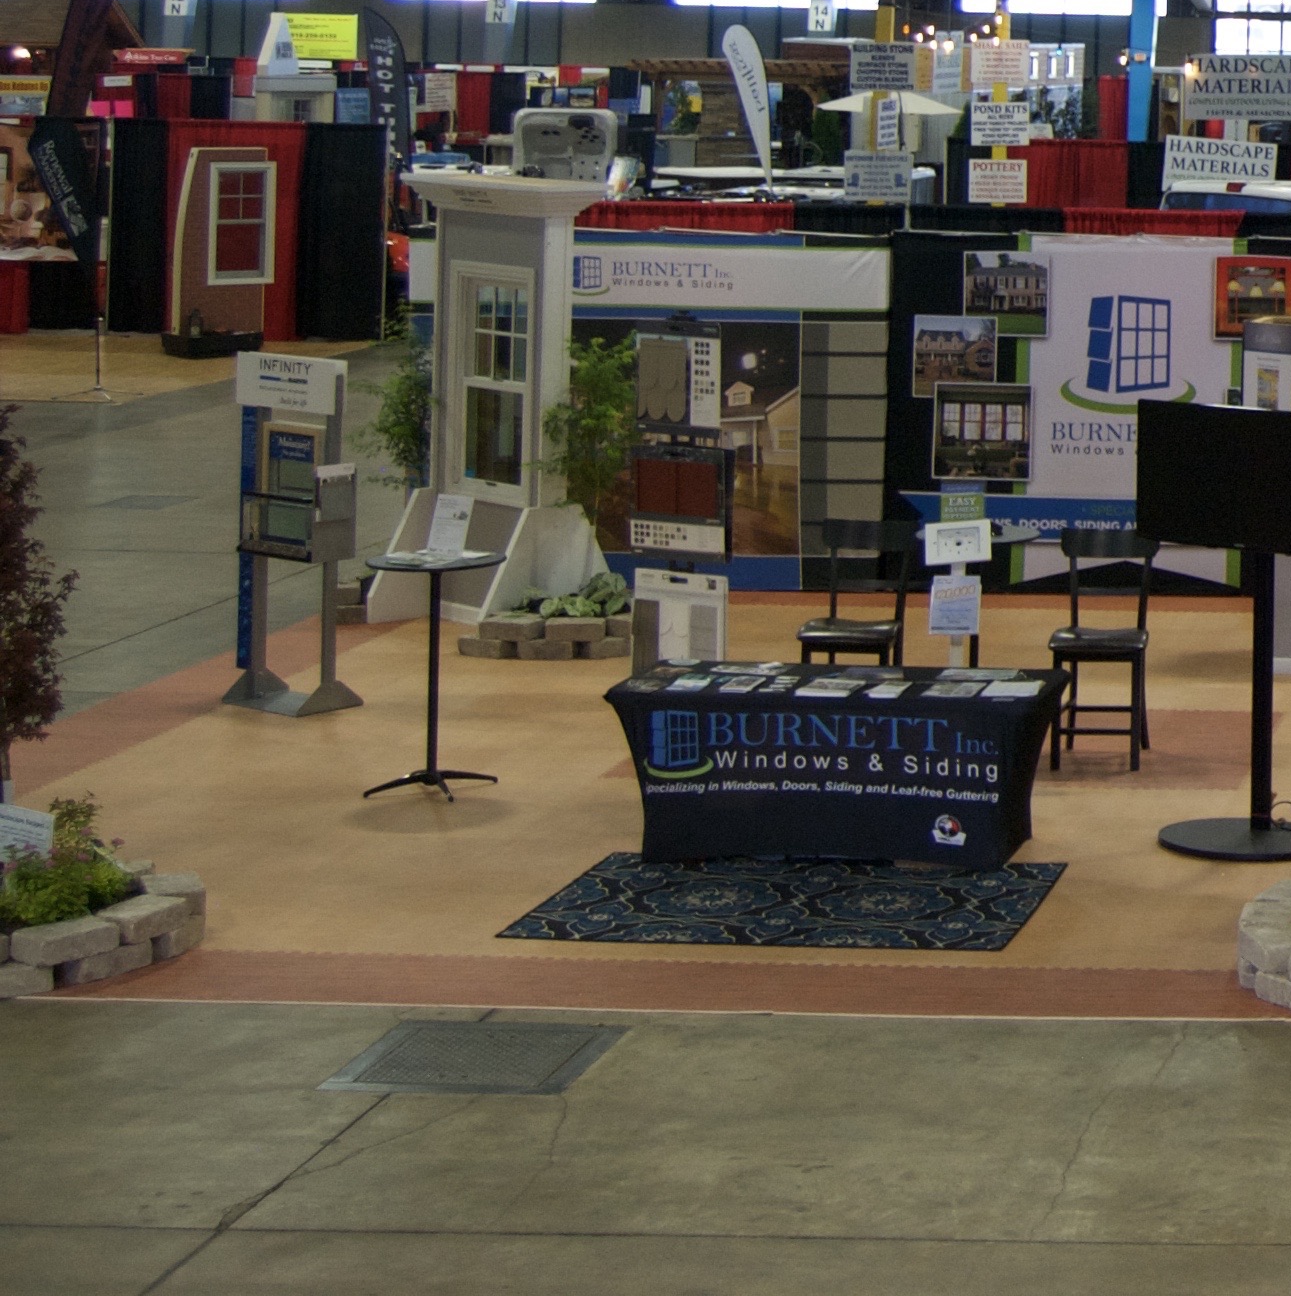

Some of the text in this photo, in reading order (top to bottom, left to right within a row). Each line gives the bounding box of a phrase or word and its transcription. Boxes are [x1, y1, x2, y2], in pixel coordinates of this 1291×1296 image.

[171, 4, 181, 14] N
[815, 5, 828, 16] 14
[492, 11, 504, 23] N
[815, 19, 825, 30] N
[889, 44, 914, 54] STONE
[974, 105, 1027, 113] POND KITS
[1169, 139, 1274, 160] HARDSCAPE
[973, 162, 1023, 172] POTTERY
[1170, 157, 1269, 177] MATERIALS
[611, 260, 713, 278] BURNETT
[611, 278, 734, 291] Windows & Siding
[259, 357, 312, 375] INFINITY
[1051, 443, 1125, 456] Windows
[948, 497, 976, 506] EASY
[706, 711, 1000, 755] BURNETT Inc.
[715, 750, 1000, 783] Windows & Siding
[707, 780, 1000, 803] in Windows, Doors, Siding and Leaf-free Guttering
